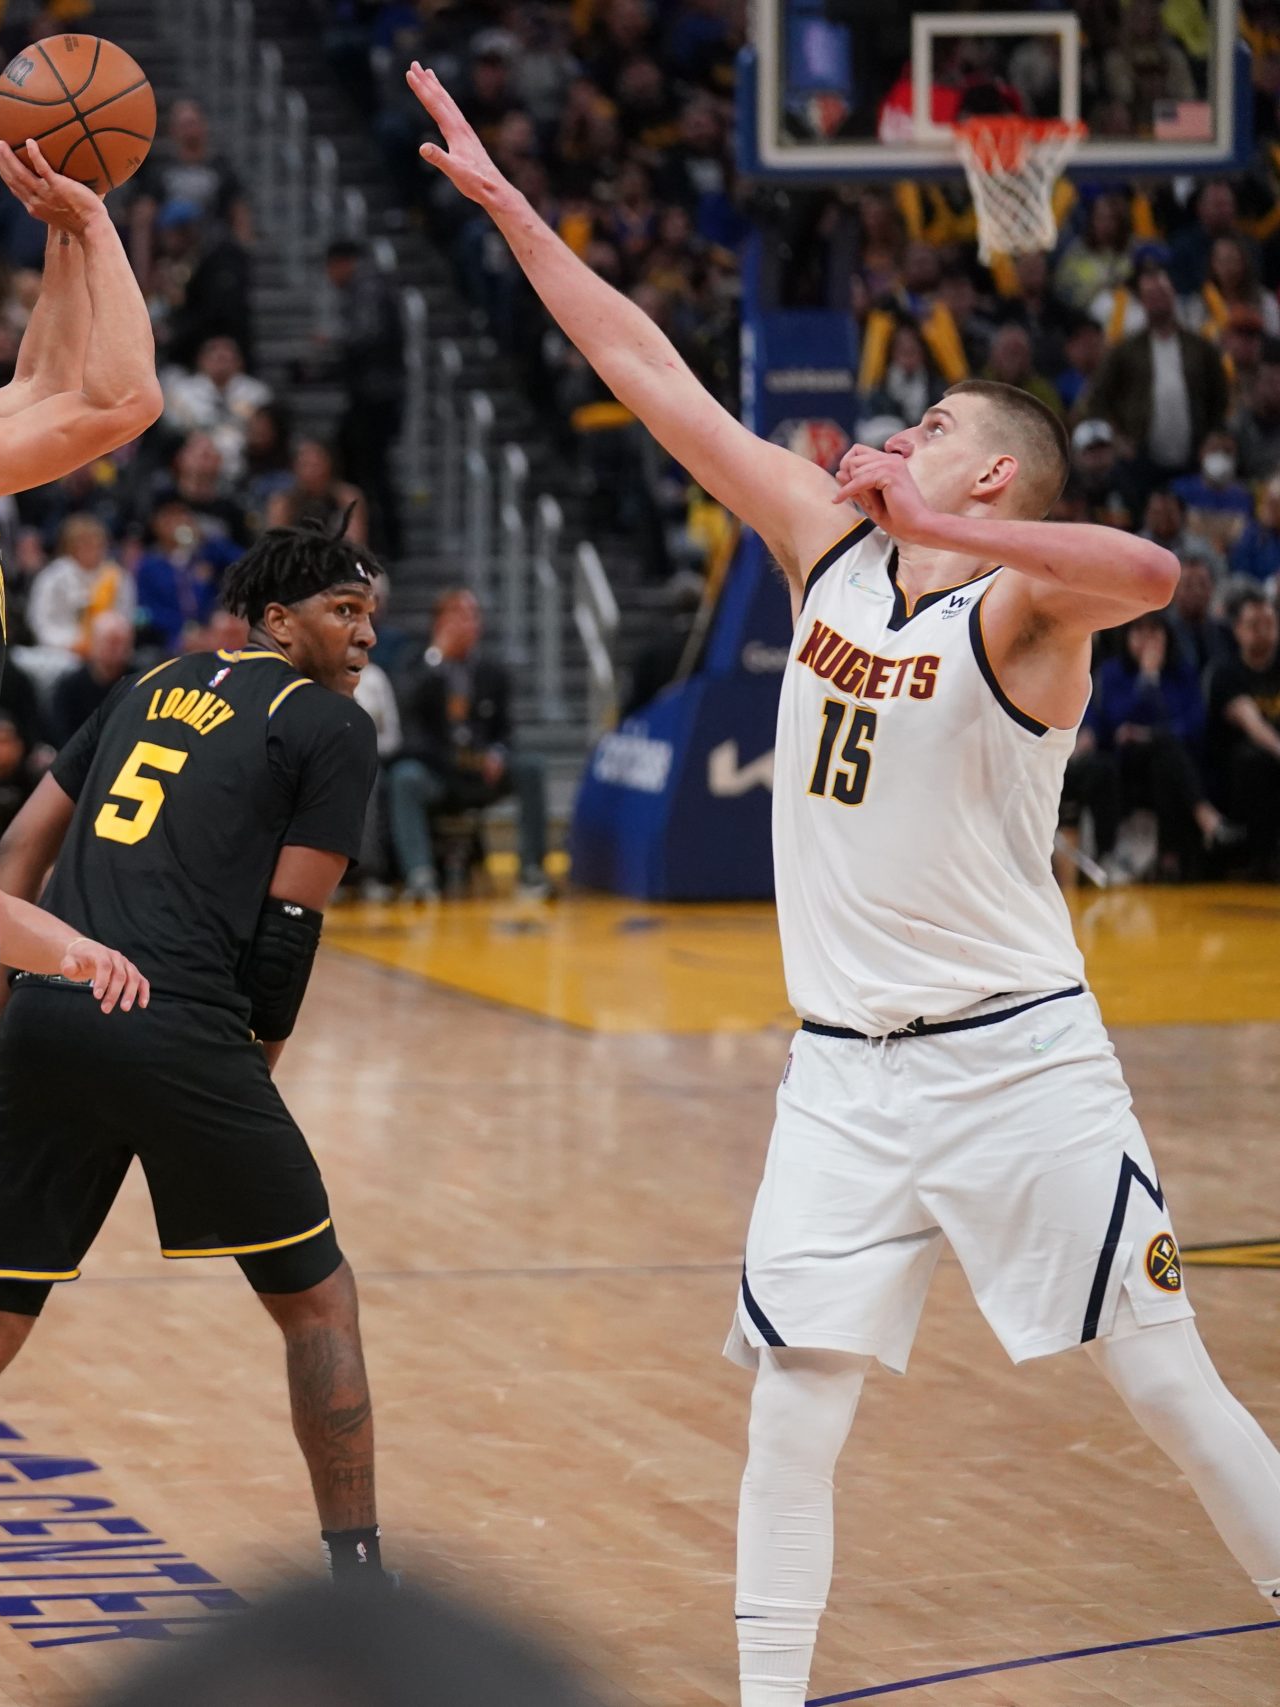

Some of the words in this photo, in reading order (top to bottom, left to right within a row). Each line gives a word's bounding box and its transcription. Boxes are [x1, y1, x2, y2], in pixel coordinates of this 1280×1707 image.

[146, 687, 235, 736] LOONEY
[806, 696, 877, 808] 15
[94, 741, 188, 845] 5
